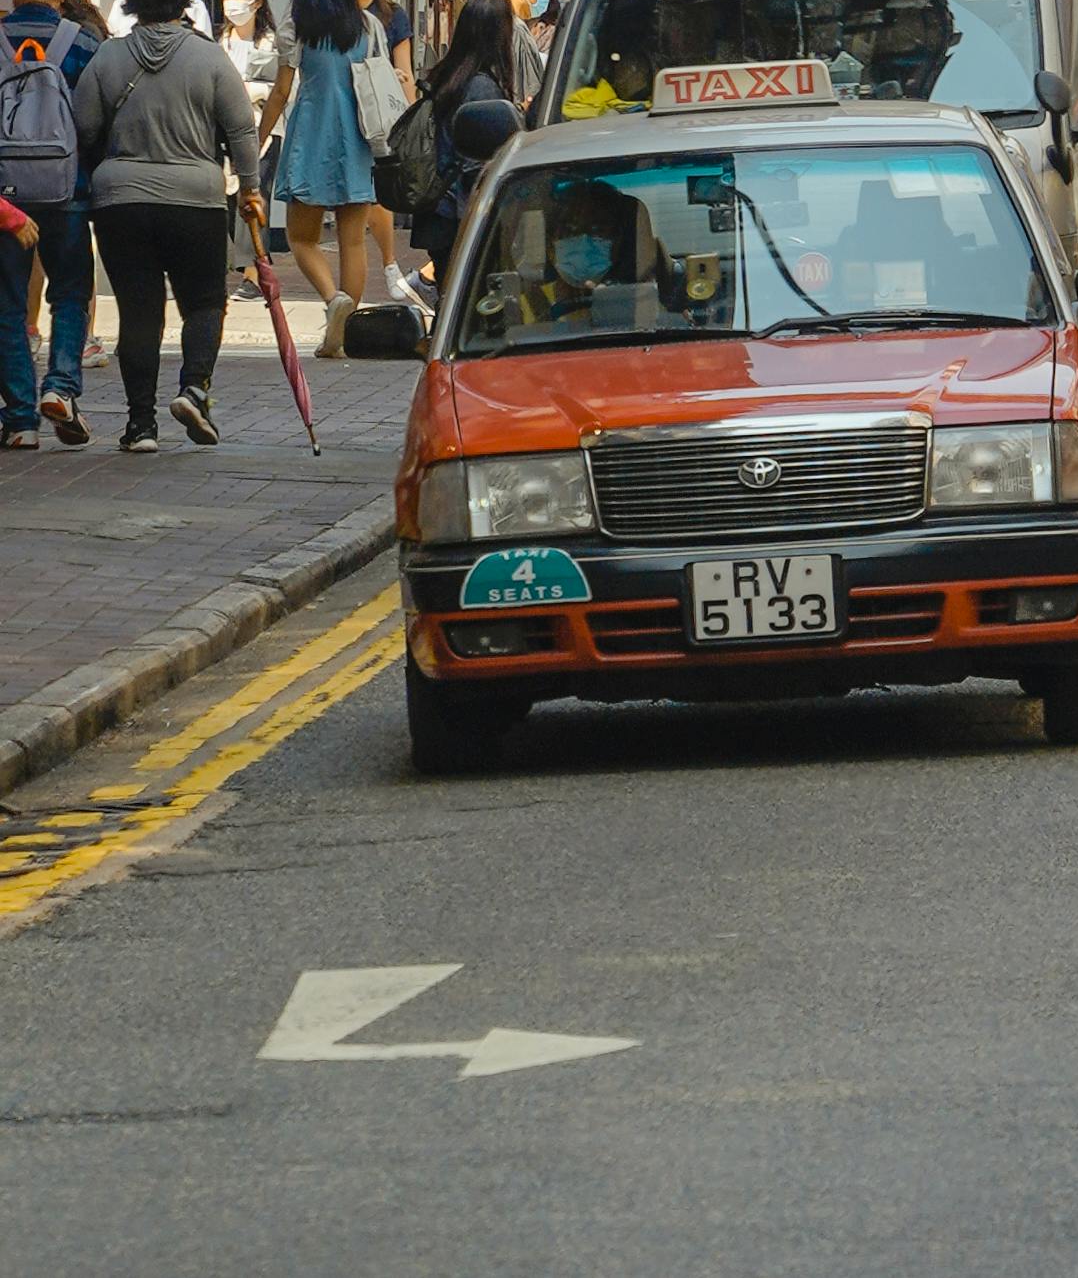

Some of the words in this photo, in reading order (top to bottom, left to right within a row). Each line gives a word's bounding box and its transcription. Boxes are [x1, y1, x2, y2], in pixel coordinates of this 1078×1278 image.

[665, 64, 814, 103] TAXI
[798, 262, 829, 282] TAXI
[511, 559, 537, 585] 4
[733, 559, 791, 599] RV
[488, 584, 564, 603] SEATS
[700, 594, 830, 639] 5133
